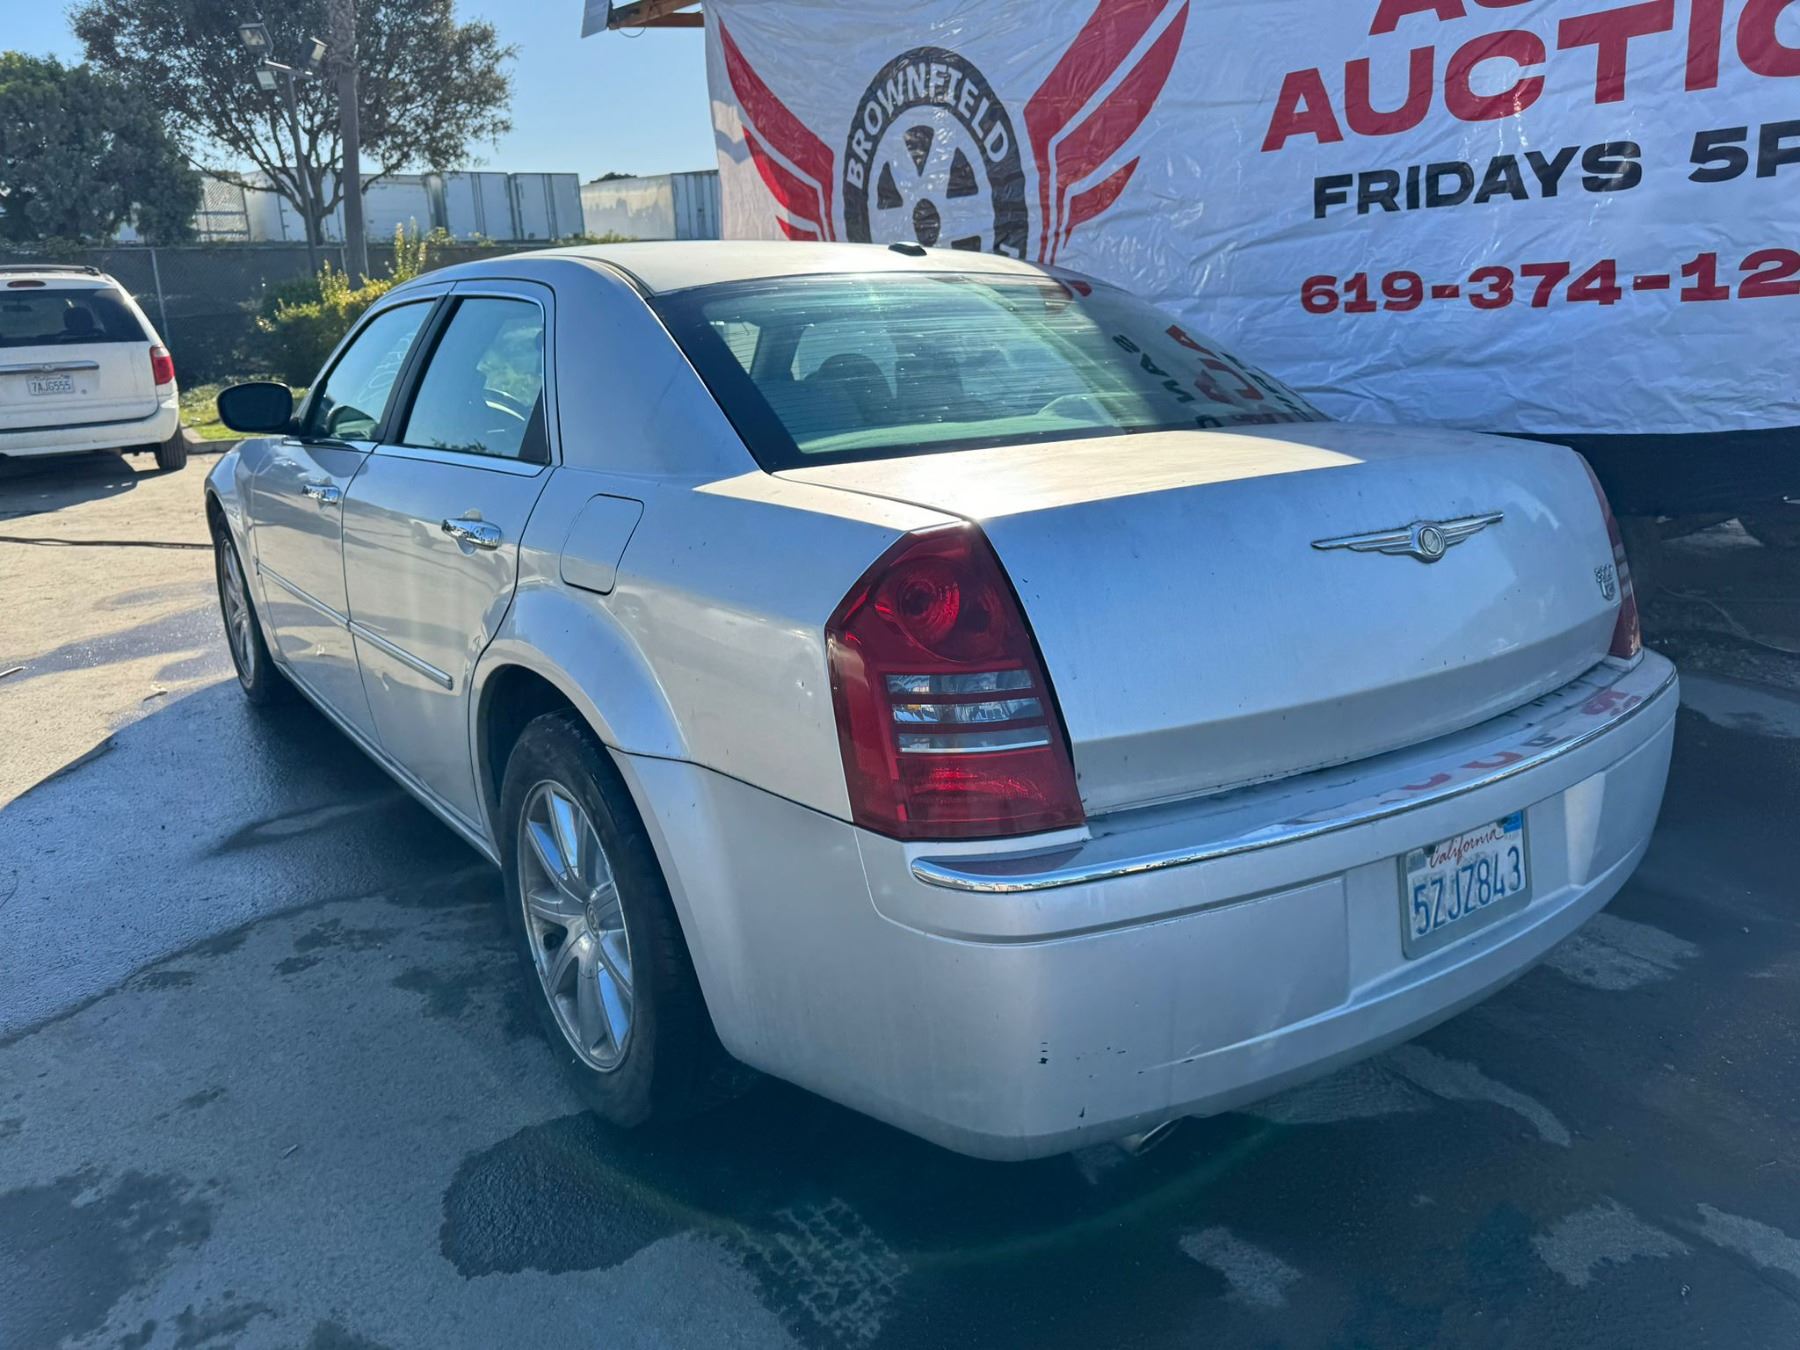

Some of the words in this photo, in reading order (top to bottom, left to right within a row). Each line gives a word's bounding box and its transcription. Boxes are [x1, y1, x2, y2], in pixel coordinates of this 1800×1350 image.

[847, 62, 1009, 189] BROWNFIELD
[1314, 141, 1642, 219] FRIDAYS
[1688, 119, 1800, 182] 5P
[1300, 248, 1800, 314] 619-374-12
[1413, 845, 1522, 936] 5ZJZ843
[1430, 827, 1504, 868] California
